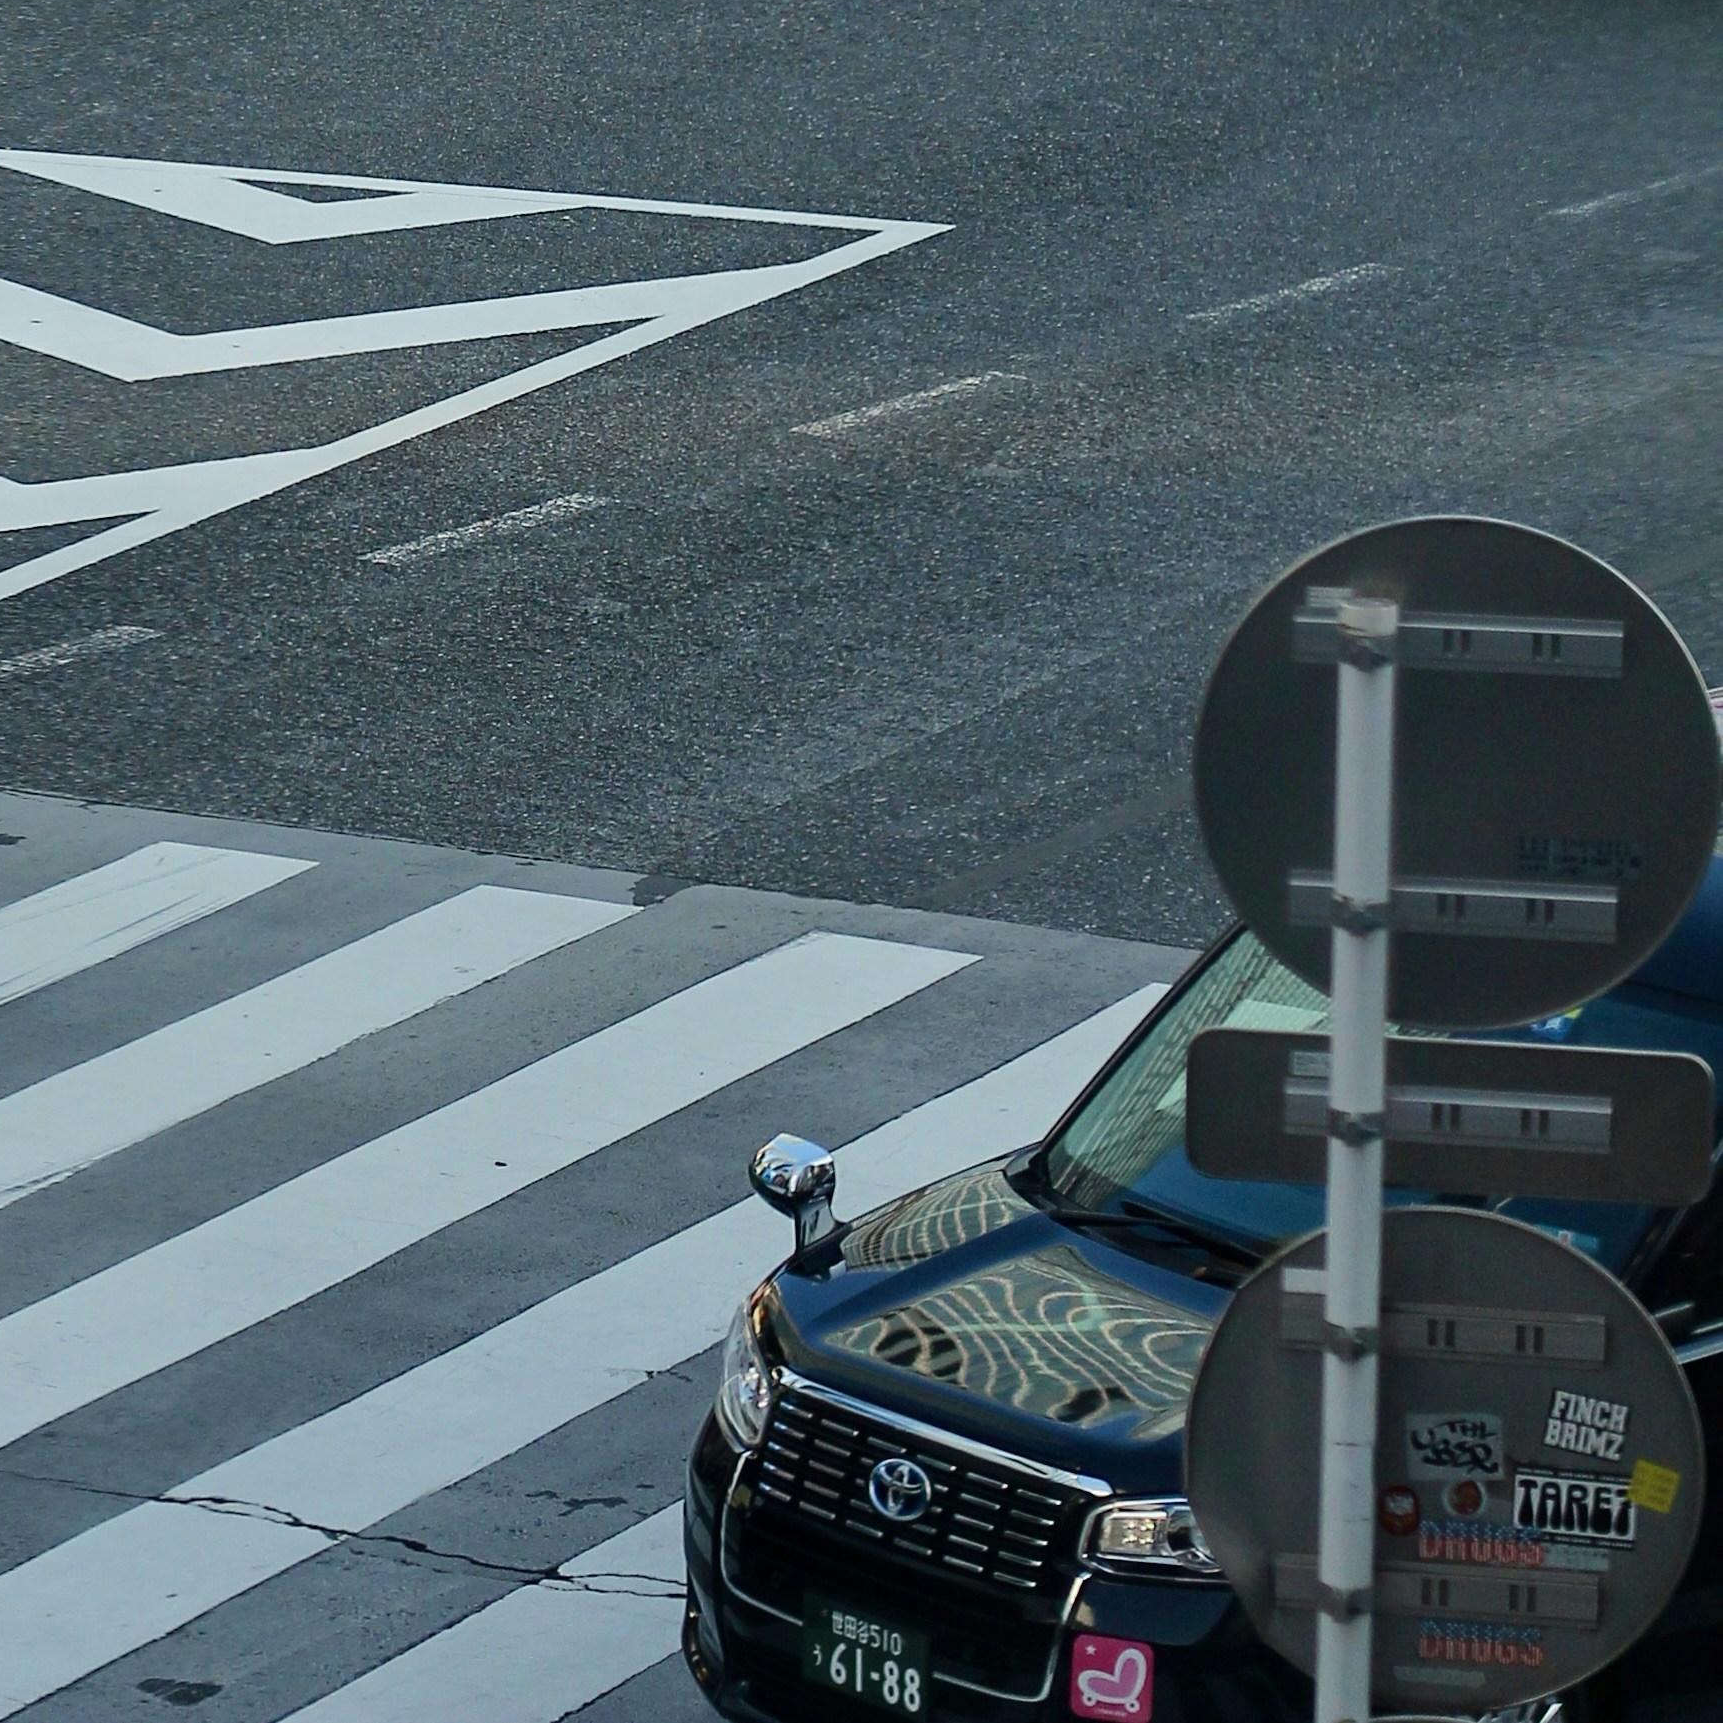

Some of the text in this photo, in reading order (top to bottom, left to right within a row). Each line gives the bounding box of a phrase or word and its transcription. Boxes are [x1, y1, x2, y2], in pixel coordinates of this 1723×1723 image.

[1549, 1388, 1629, 1433] FINCH
[1543, 1417, 1625, 1462] BRIMZ
[829, 1642, 922, 1713] 61-88
